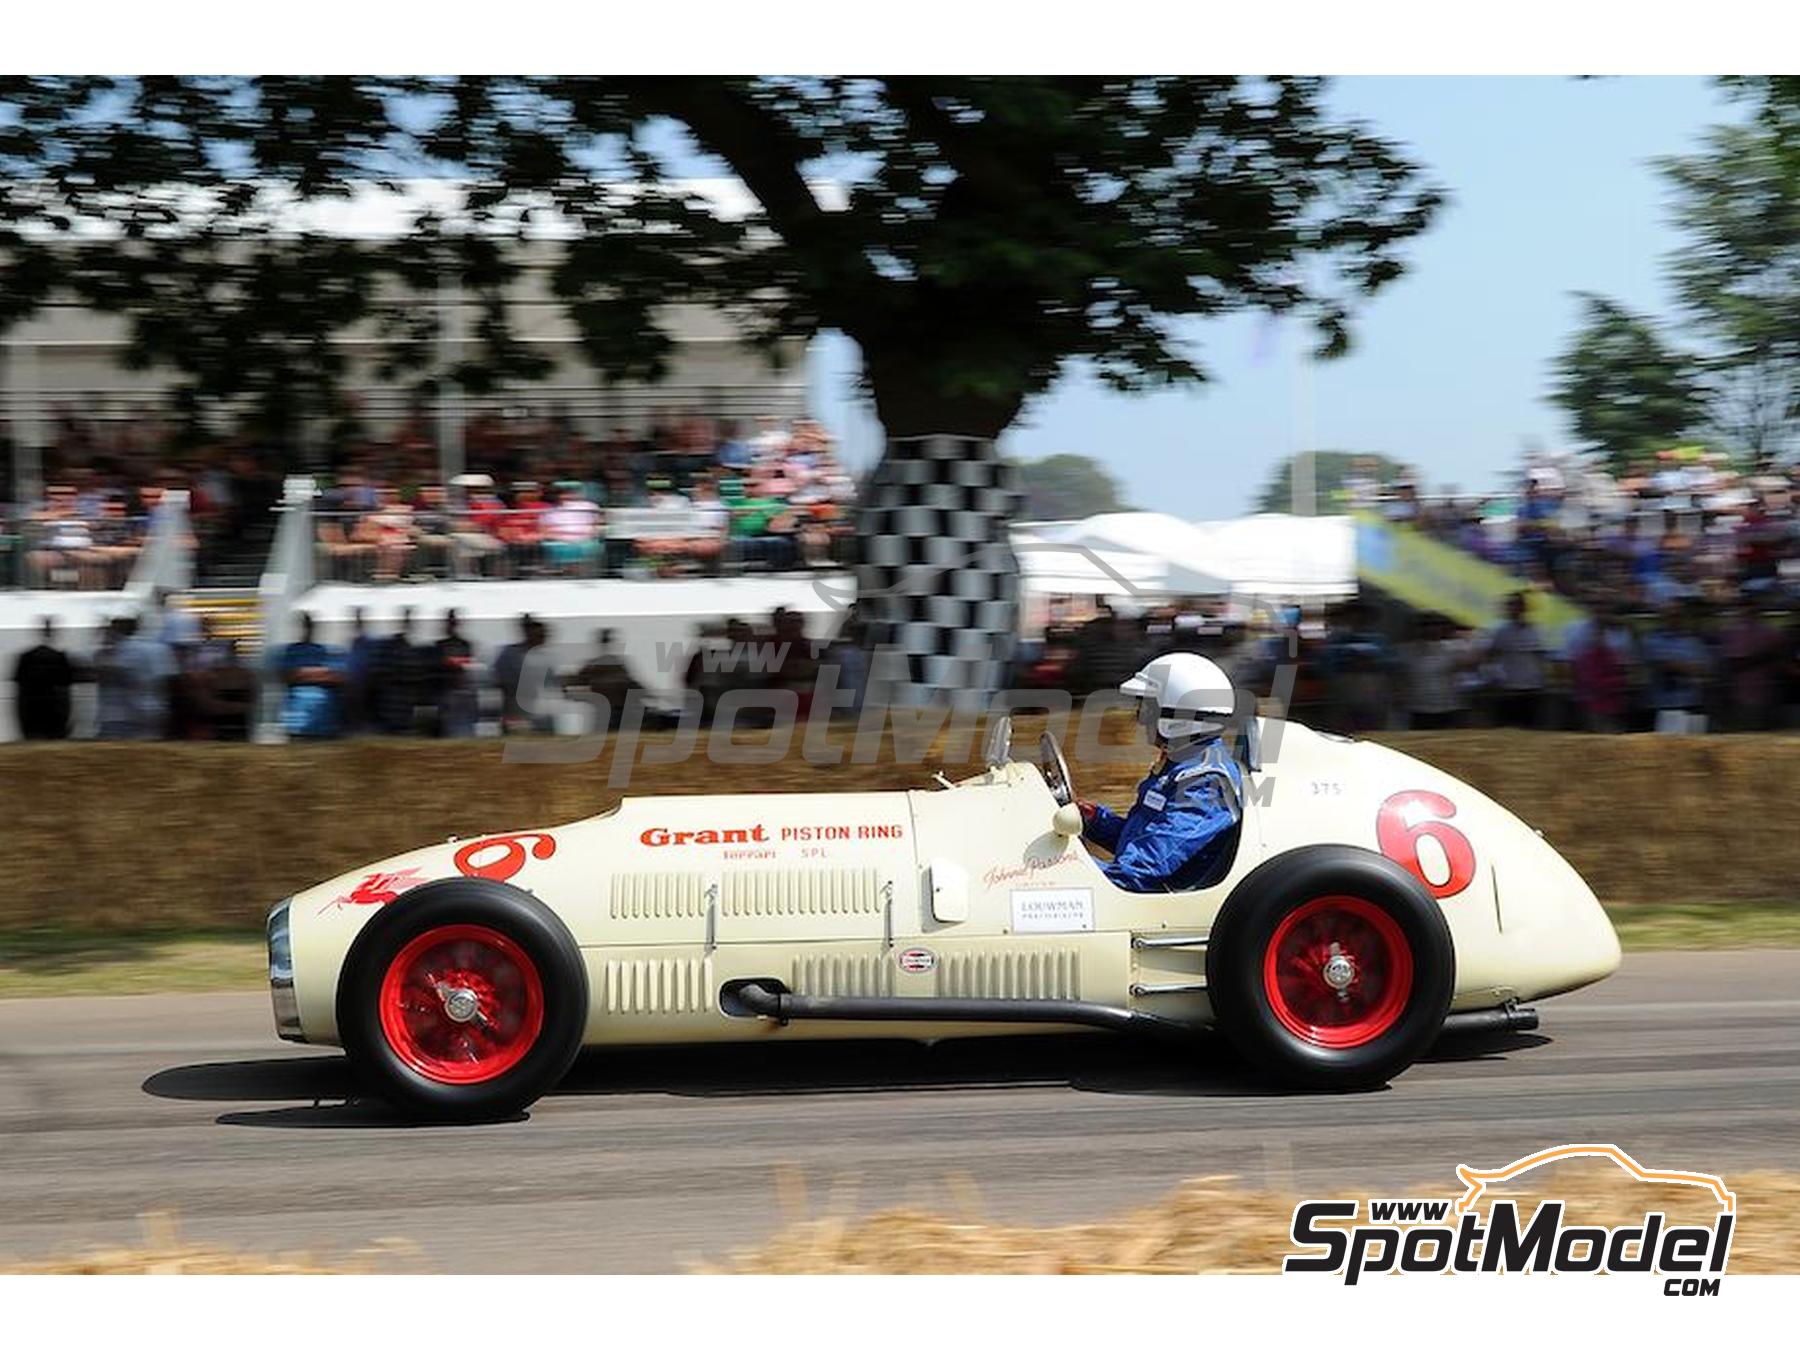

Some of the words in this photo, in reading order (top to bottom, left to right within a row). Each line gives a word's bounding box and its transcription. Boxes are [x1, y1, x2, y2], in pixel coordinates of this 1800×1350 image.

[639, 823, 770, 847] Grant
[782, 826, 850, 841] PISTON
[858, 825, 904, 839] RING
[1376, 789, 1477, 899] 6
